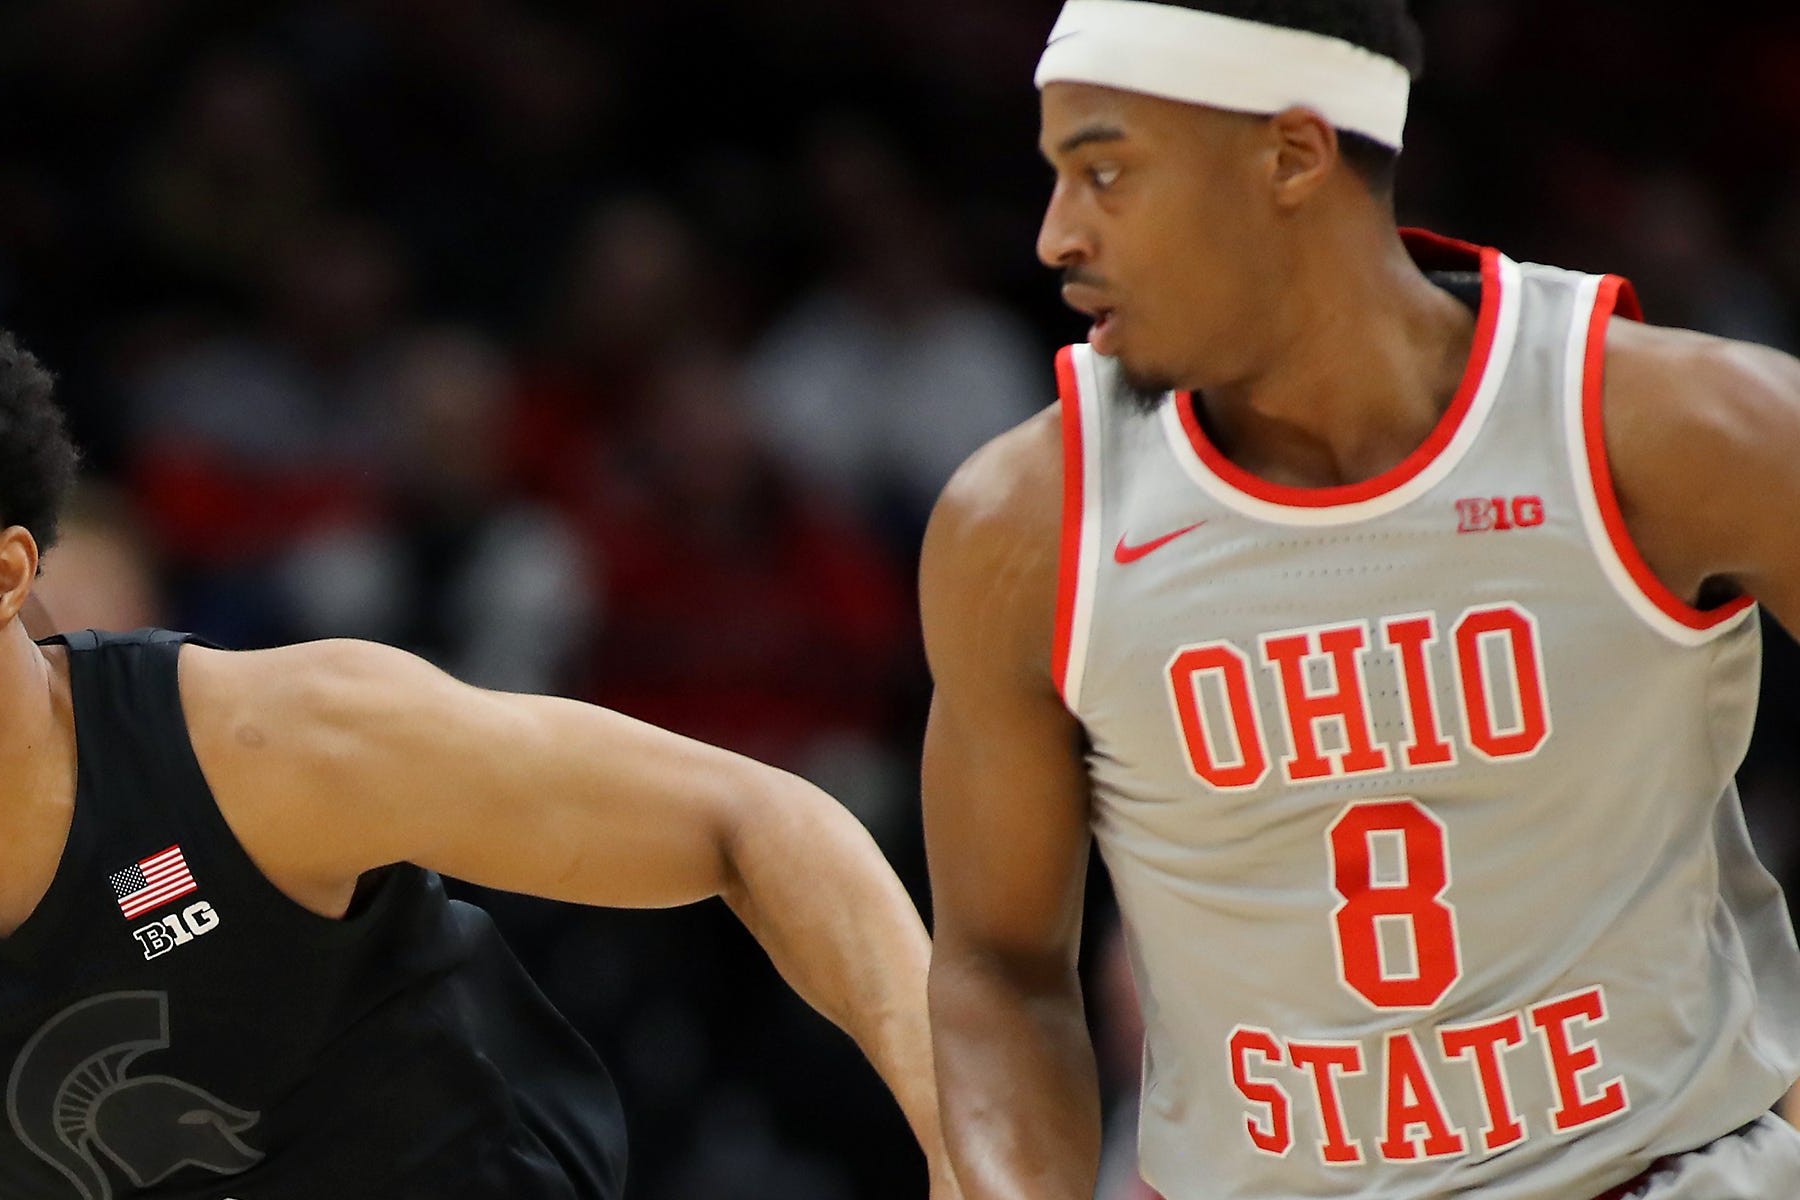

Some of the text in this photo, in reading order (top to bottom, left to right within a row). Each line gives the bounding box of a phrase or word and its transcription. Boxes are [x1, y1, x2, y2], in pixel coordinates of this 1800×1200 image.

[1164, 600, 1552, 790] OHIO
[1324, 797, 1463, 1011] 8
[1225, 984, 1630, 1166] STATE
